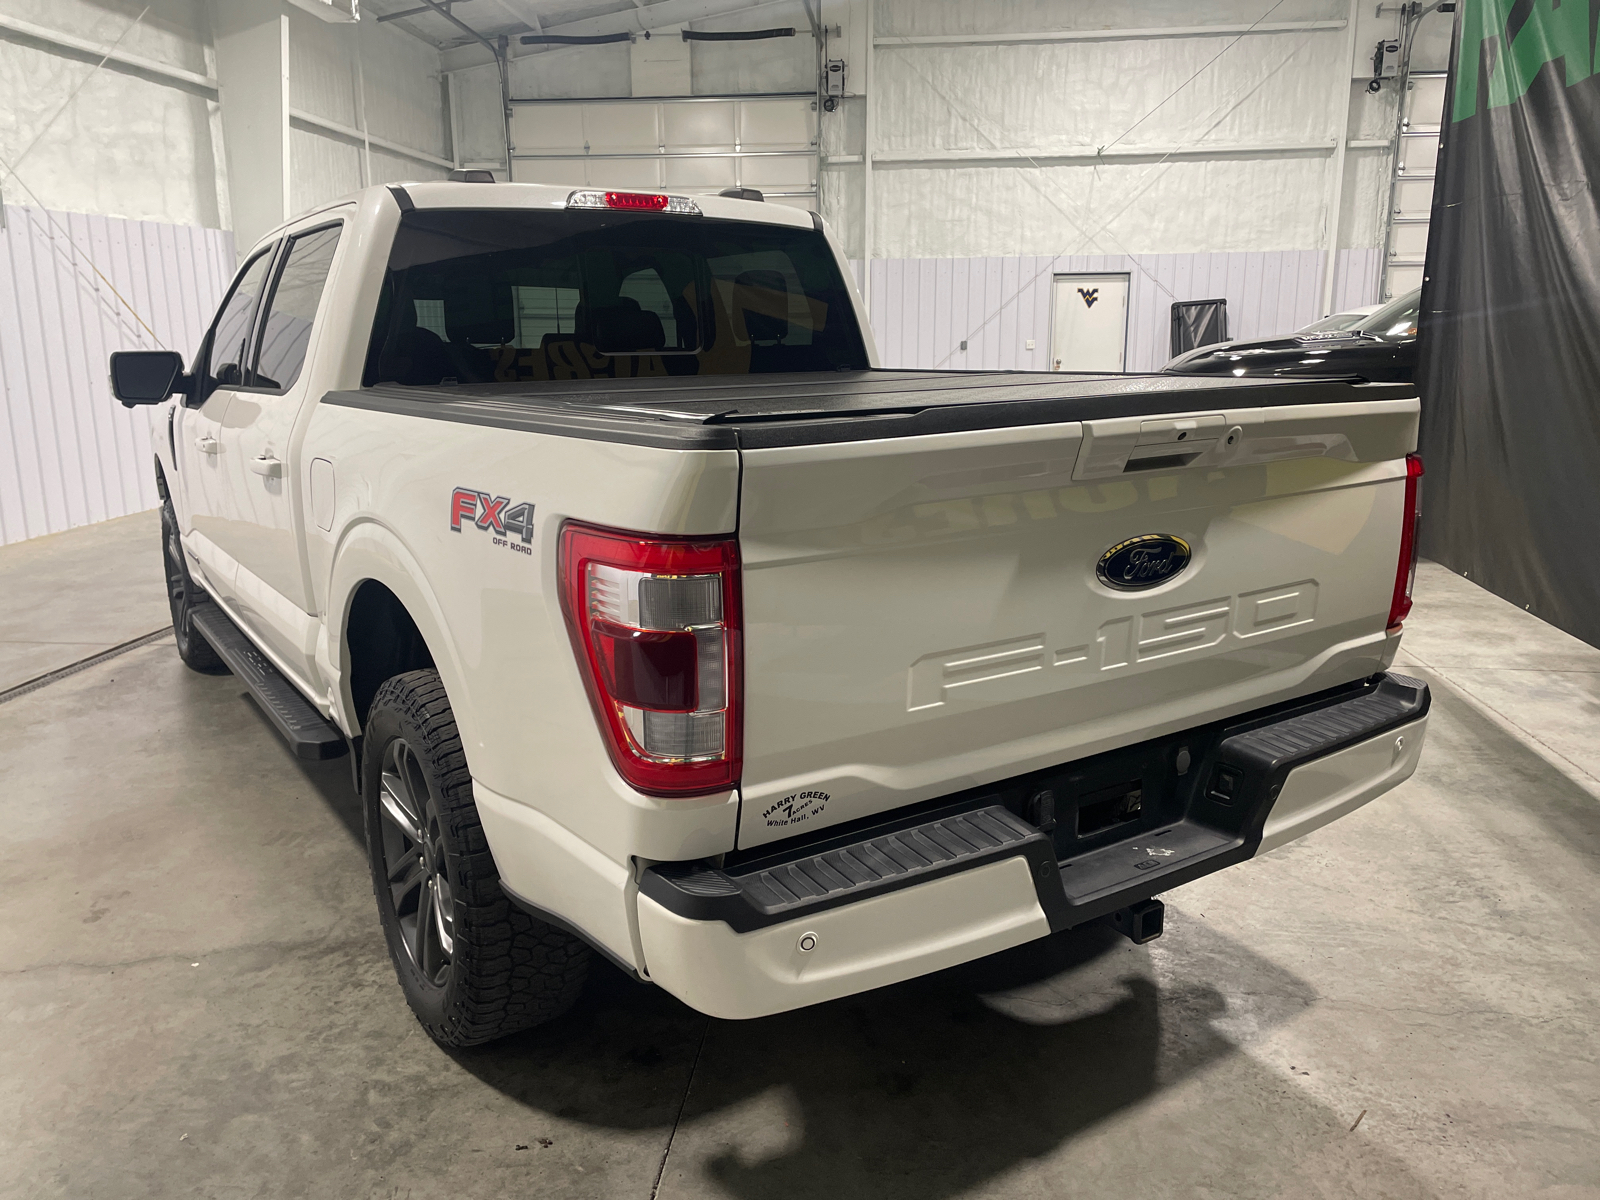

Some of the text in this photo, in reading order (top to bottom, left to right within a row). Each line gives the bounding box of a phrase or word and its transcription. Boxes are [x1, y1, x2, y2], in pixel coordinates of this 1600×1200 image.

[451, 486, 535, 545] FX4
[492, 537, 532, 556] OFF ROAD
[1123, 546, 1175, 580] Ford
[907, 579, 1319, 712] F-150
[762, 791, 831, 819] HARRY GREEN
[766, 804, 825, 827] White Hall, WV
[782, 799, 813, 819] 7 ACRES
